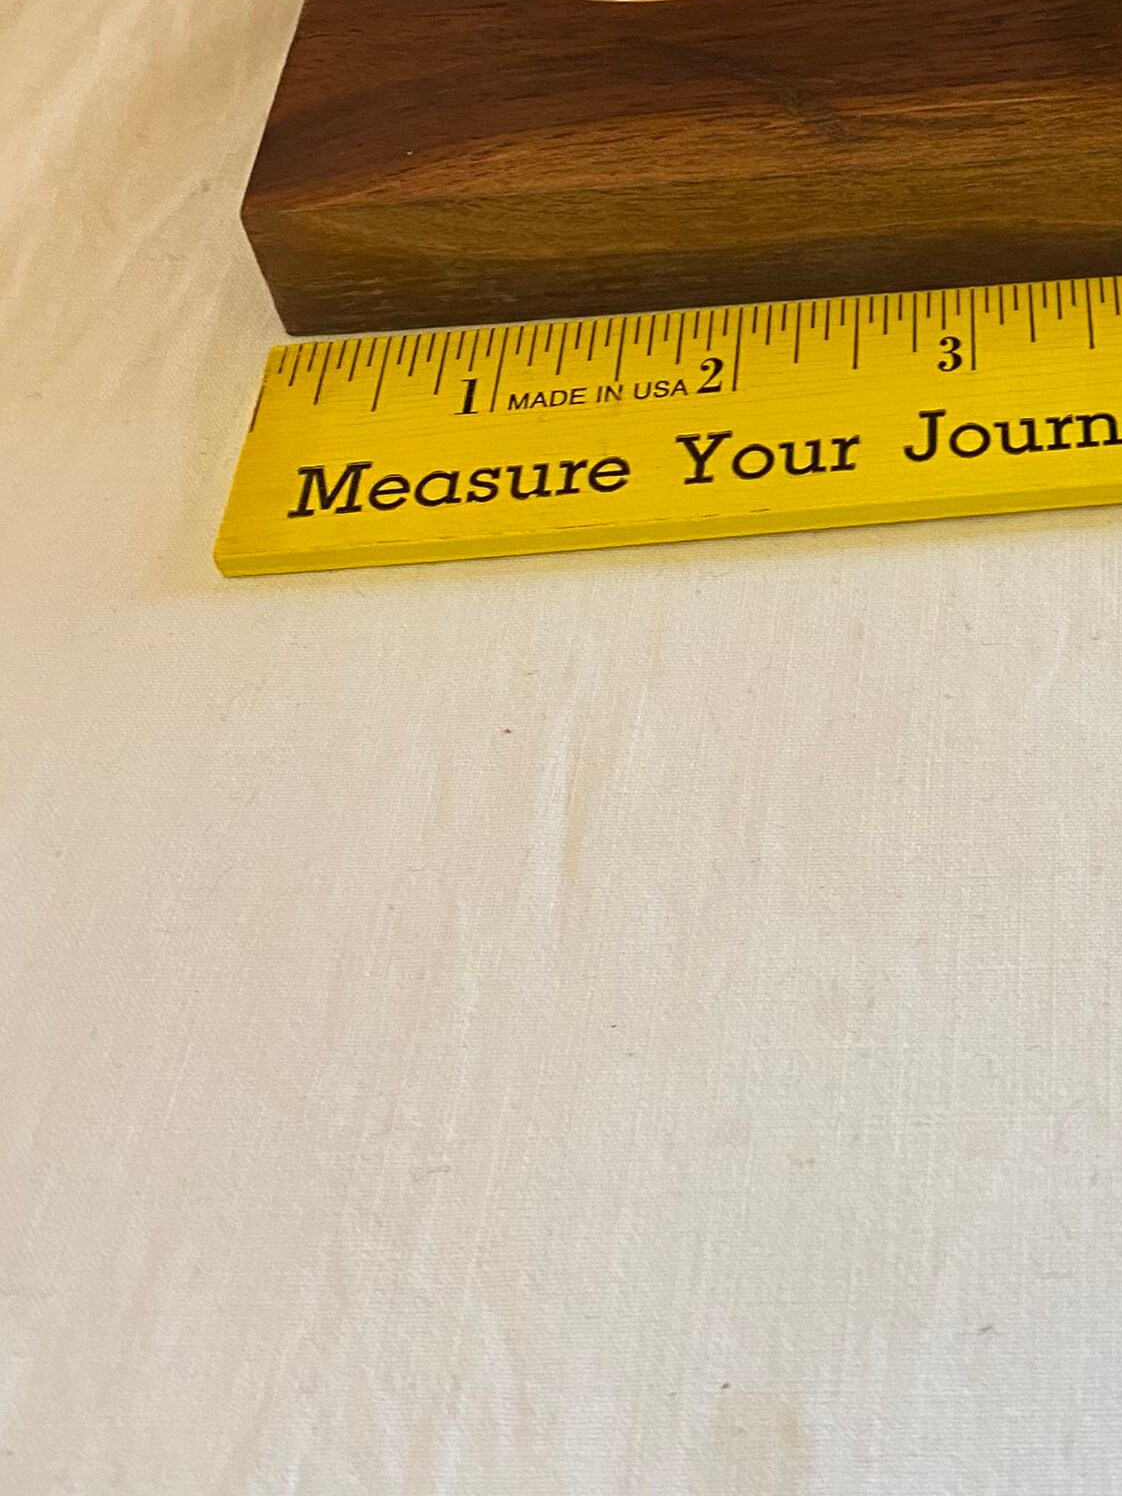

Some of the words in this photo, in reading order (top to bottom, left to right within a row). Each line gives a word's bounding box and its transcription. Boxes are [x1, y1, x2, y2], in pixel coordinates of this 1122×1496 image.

[453, 378, 479, 416] 1
[697, 357, 724, 394] 2
[937, 336, 963, 372] 3
[507, 387, 588, 411] MADE
[596, 383, 624, 404] IN
[634, 379, 688, 400] USA
[287, 453, 632, 519] Measure
[675, 429, 862, 485] Your
